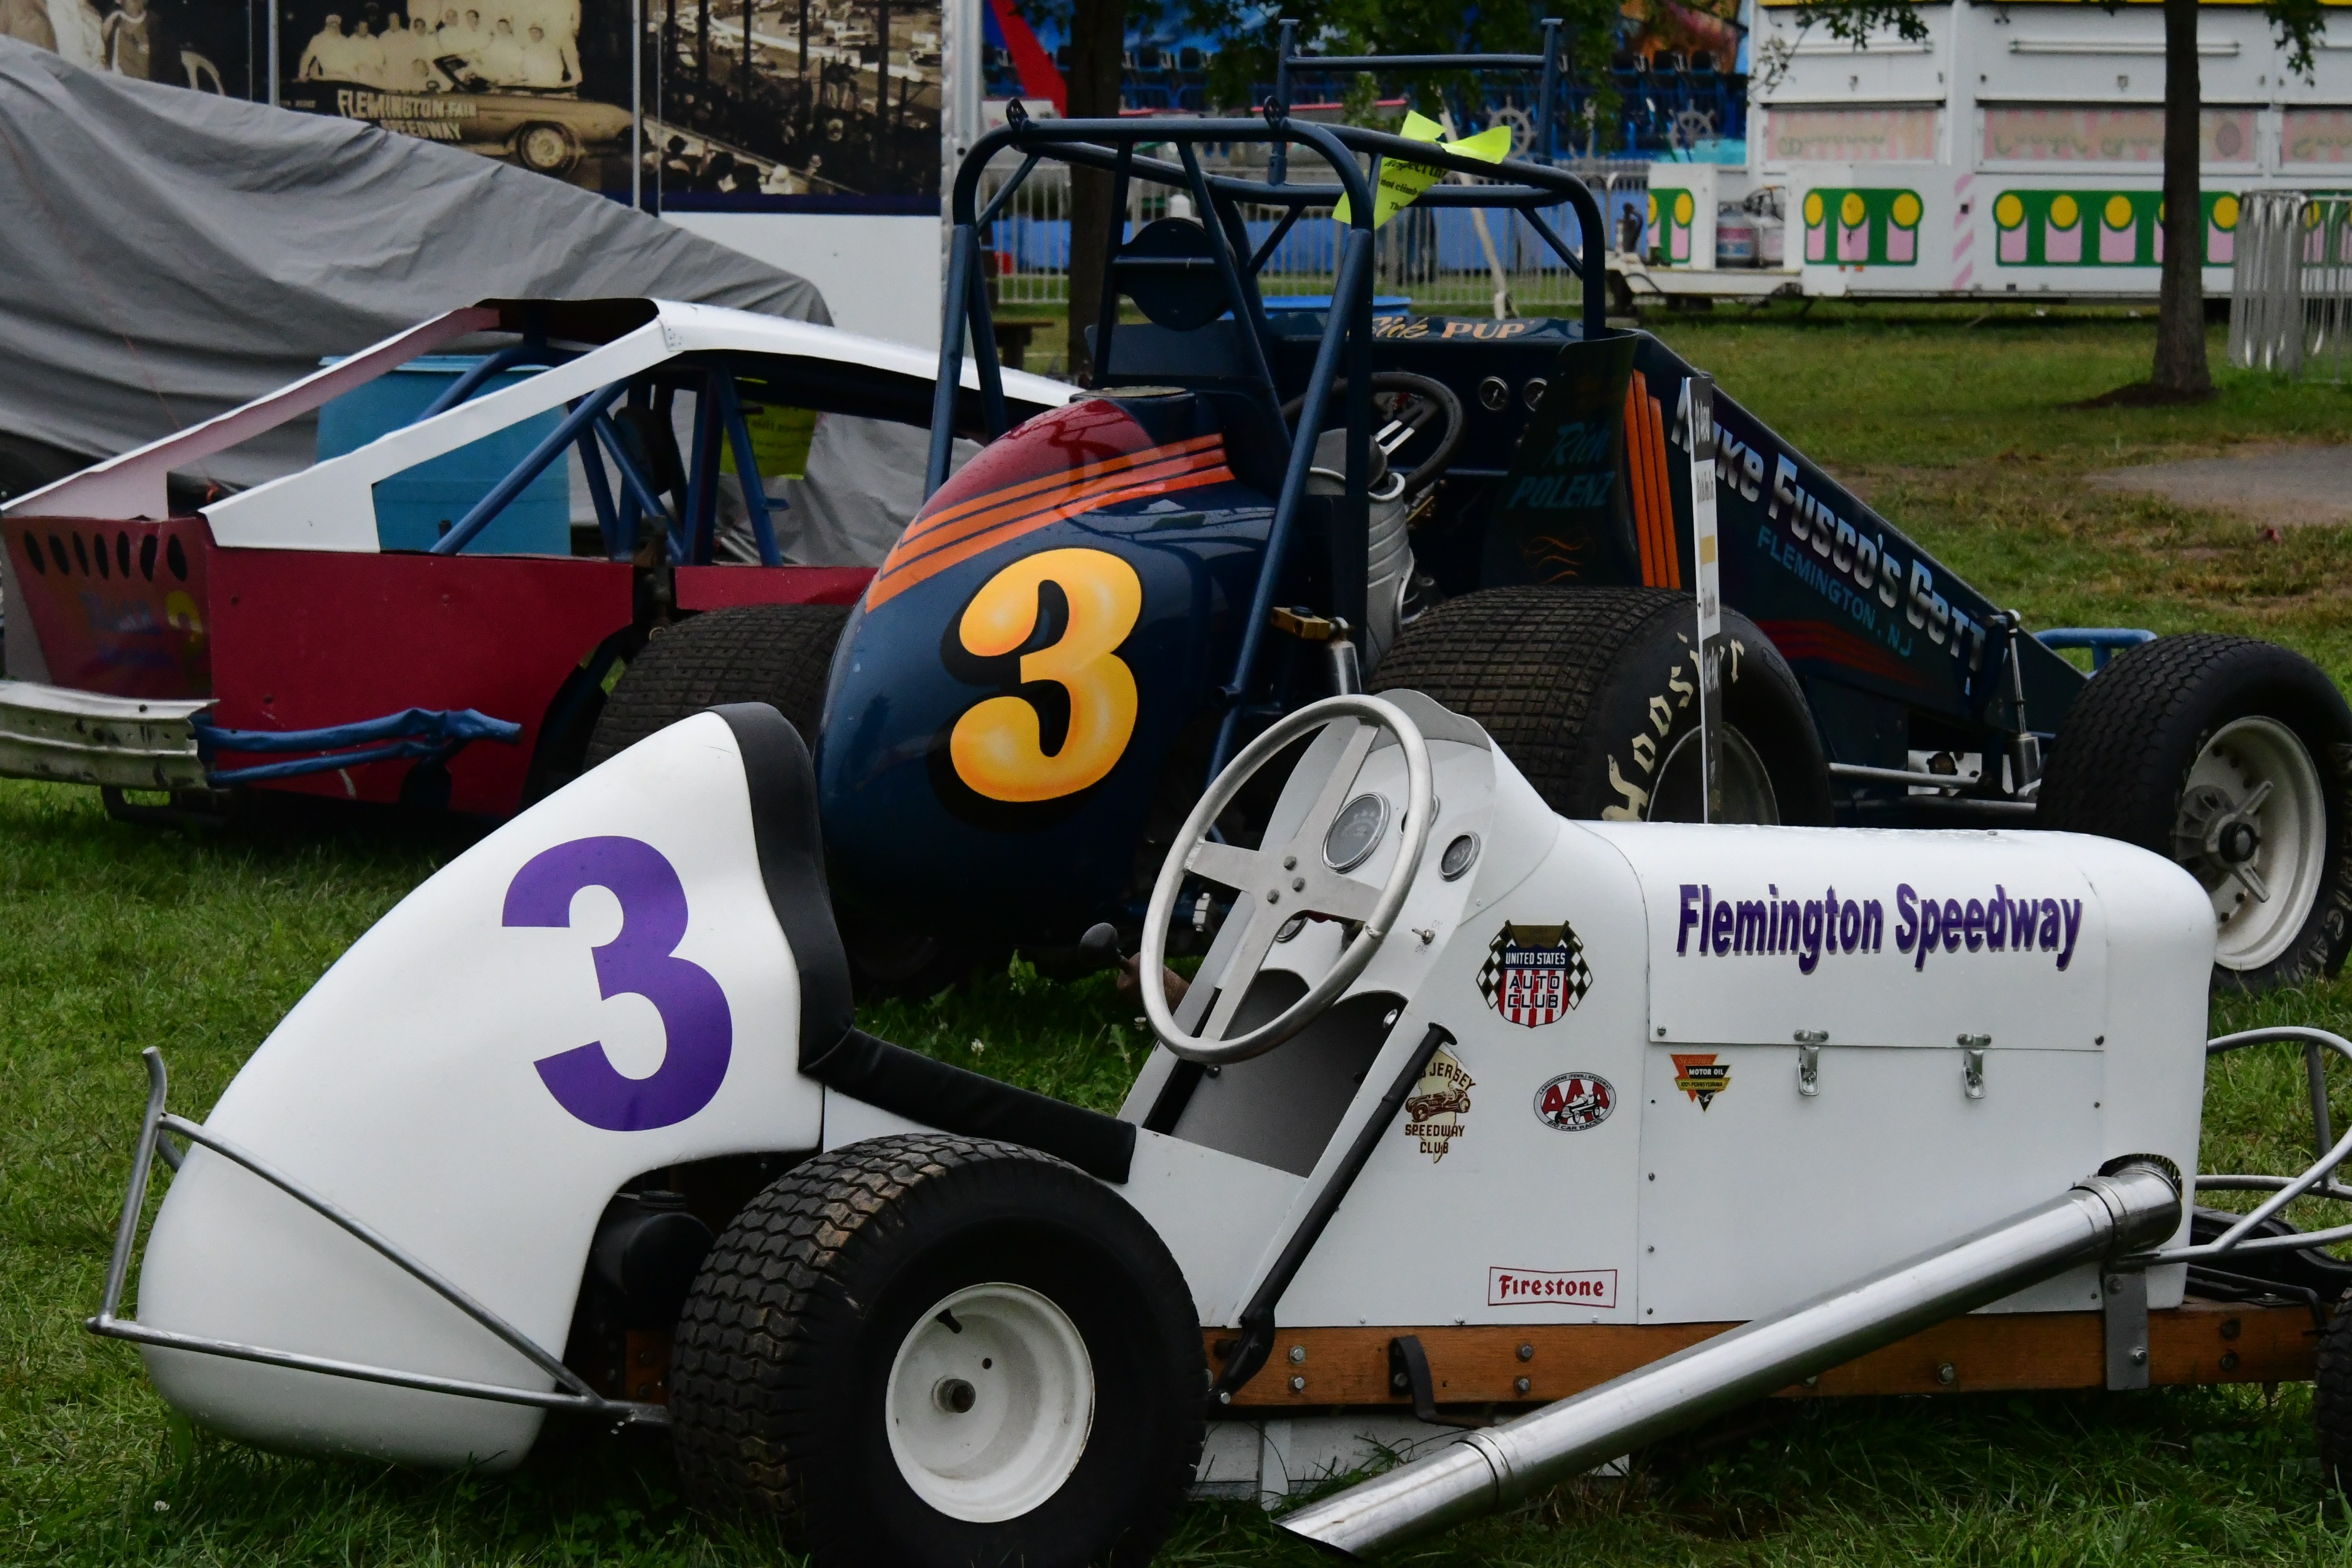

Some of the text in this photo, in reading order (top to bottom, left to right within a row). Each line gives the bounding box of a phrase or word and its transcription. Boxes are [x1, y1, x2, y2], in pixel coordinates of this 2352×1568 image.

[1887, 621, 1913, 658] NJ
[1906, 559, 2008, 696] Gett
[951, 546, 1143, 803] 3
[1676, 882, 2084, 975] Flemington Speedway
[1505, 952, 1566, 965] UNITED STATES
[502, 835, 733, 1132] 3
[1509, 975, 1560, 990] AUTO
[1507, 994, 1559, 1009] CLUB
[1429, 1062, 1477, 1091] JERSEY
[1588, 1075, 1612, 1090] SPEEDWAY
[1541, 1079, 1610, 1124] AAA
[1405, 1124, 1465, 1137] SPEEDWAY
[1547, 1120, 1559, 1128] BIG
[1420, 1141, 1450, 1154] CLUB
[1498, 1274, 1605, 1299] Firestone
